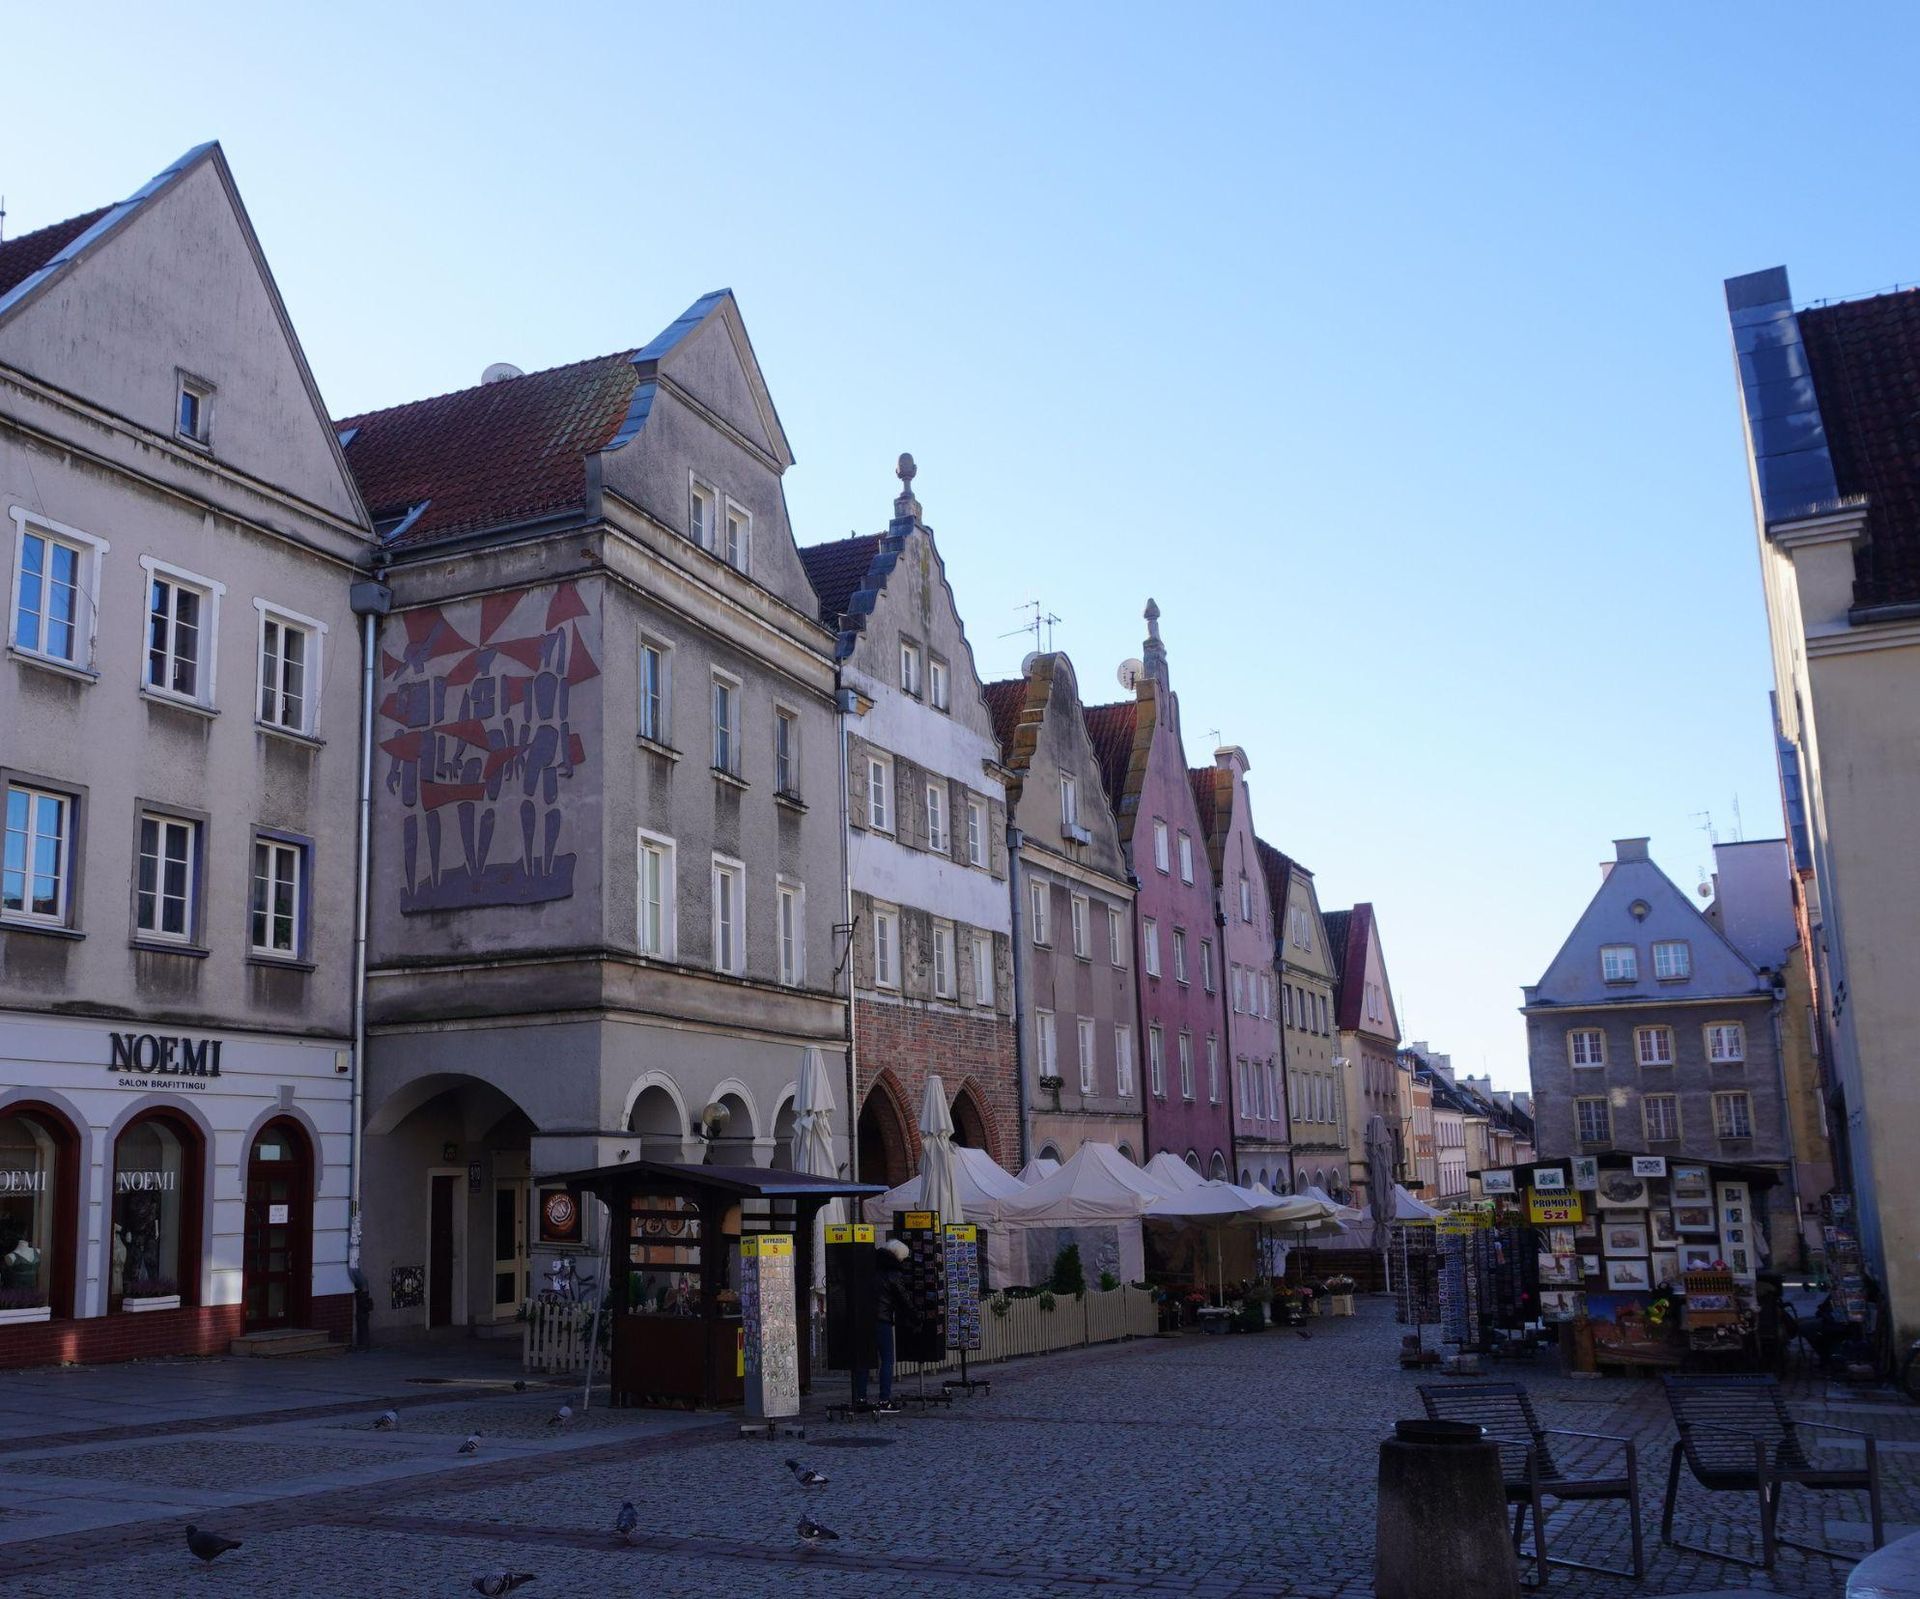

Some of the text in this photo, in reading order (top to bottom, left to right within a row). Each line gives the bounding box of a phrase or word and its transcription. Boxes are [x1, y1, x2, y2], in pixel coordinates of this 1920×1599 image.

[108, 1032, 222, 1077] NOEMI
[119, 1079, 206, 1090] SALON BRAFITTINGU
[119, 1171, 175, 1191] NOEMI
[1532, 1199, 1578, 1208] PROMOCJA
[1544, 1210, 1569, 1220] 5 zł
